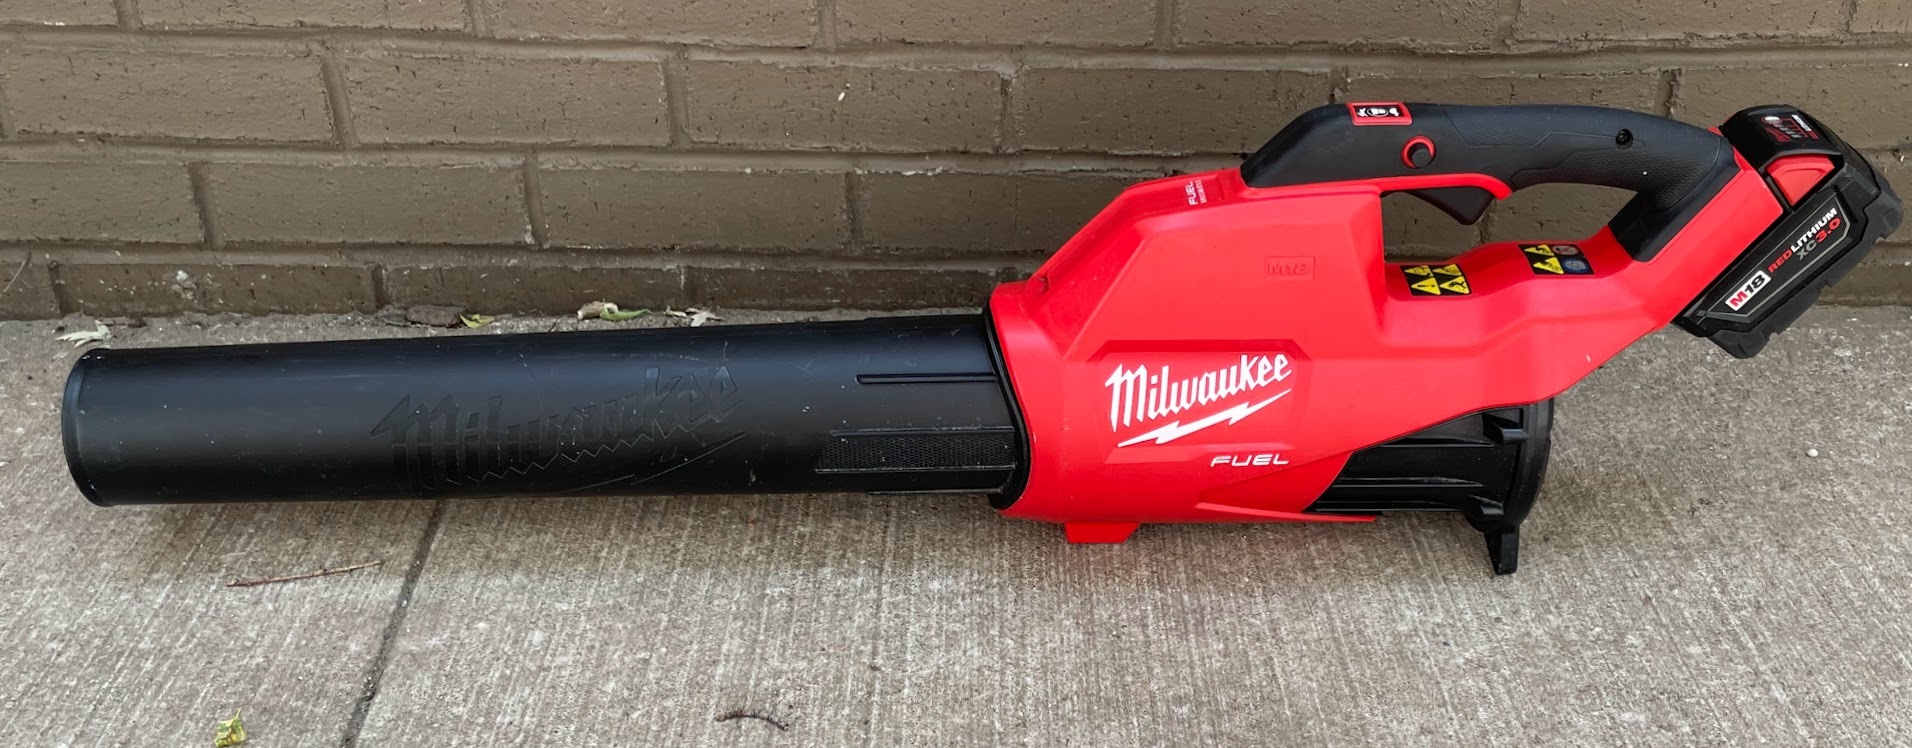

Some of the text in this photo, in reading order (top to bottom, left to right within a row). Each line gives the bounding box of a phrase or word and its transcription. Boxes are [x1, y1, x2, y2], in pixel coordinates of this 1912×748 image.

[1185, 181, 1199, 206] FUEL
[1767, 207, 1838, 273] REDLITHIUM
[1729, 274, 1766, 307] M18
[1104, 353, 1292, 433] Milwaukee
[370, 366, 742, 492] Milwaukee
[1210, 453, 1289, 468] FUEL
